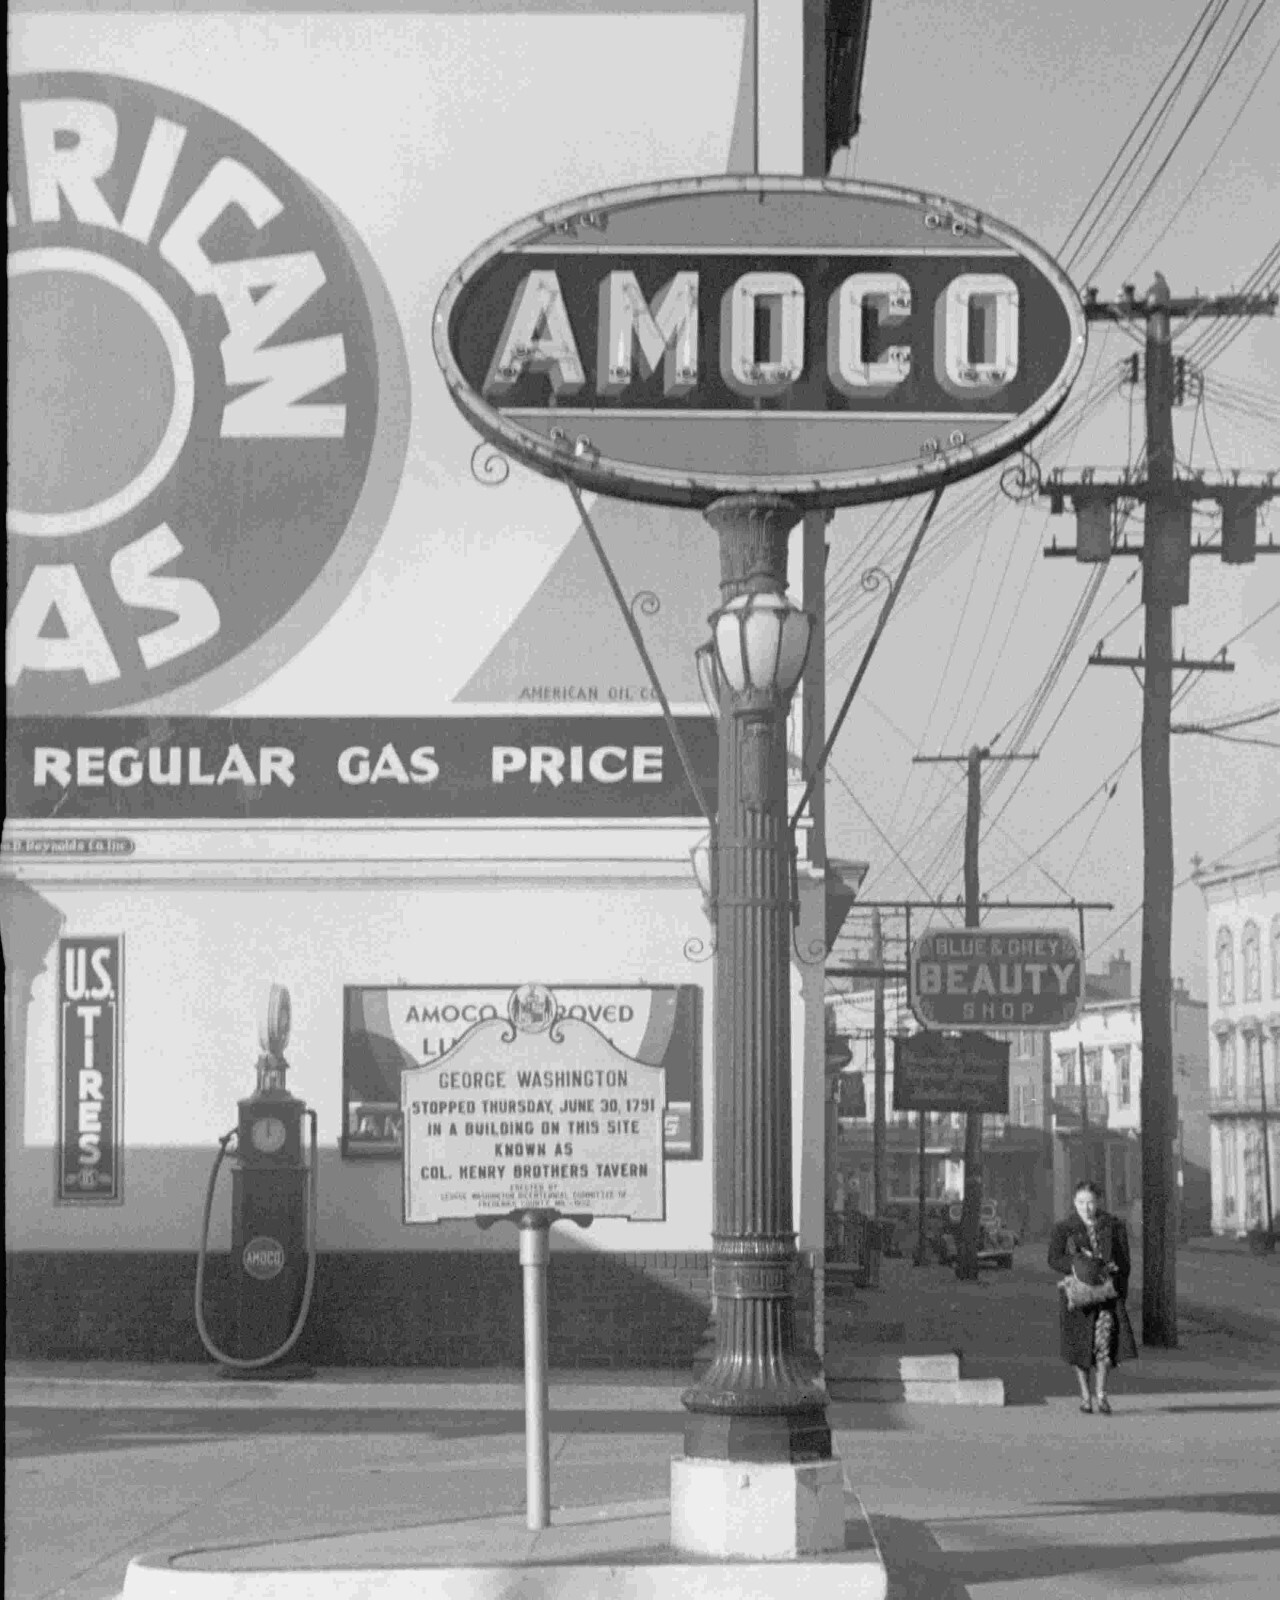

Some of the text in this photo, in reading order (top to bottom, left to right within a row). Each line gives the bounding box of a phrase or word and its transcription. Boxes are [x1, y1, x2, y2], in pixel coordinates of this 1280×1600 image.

[7, 99, 347, 438] RICAN
[484, 269, 1019, 398] AMOCO
[518, 685, 598, 701] AMERICAN
[608, 685, 633, 700] OIL
[33, 742, 664, 788] REGULAR GAS PRICE
[936, 938, 986, 955] BLUE
[919, 963, 1076, 995] BEAUTY
[406, 1004, 498, 1023] AMOCO
[963, 1002, 1034, 1020] SHOP
[77, 1006, 105, 1165] TIRES
[439, 1070, 628, 1089] GEORGE WASHINGTON
[412, 1100, 476, 1115] STOPPED
[482, 1099, 554, 1115] THURSDAY,
[559, 1099, 594, 1113] JUNE
[626, 1098, 656, 1112] 1791
[427, 1120, 640, 1136] IN A BUILDING ON THIS SITE
[494, 1142, 573, 1157] KNOWN AS
[420, 1163, 649, 1180] COL. HENRY BROTHERS TAVERN
